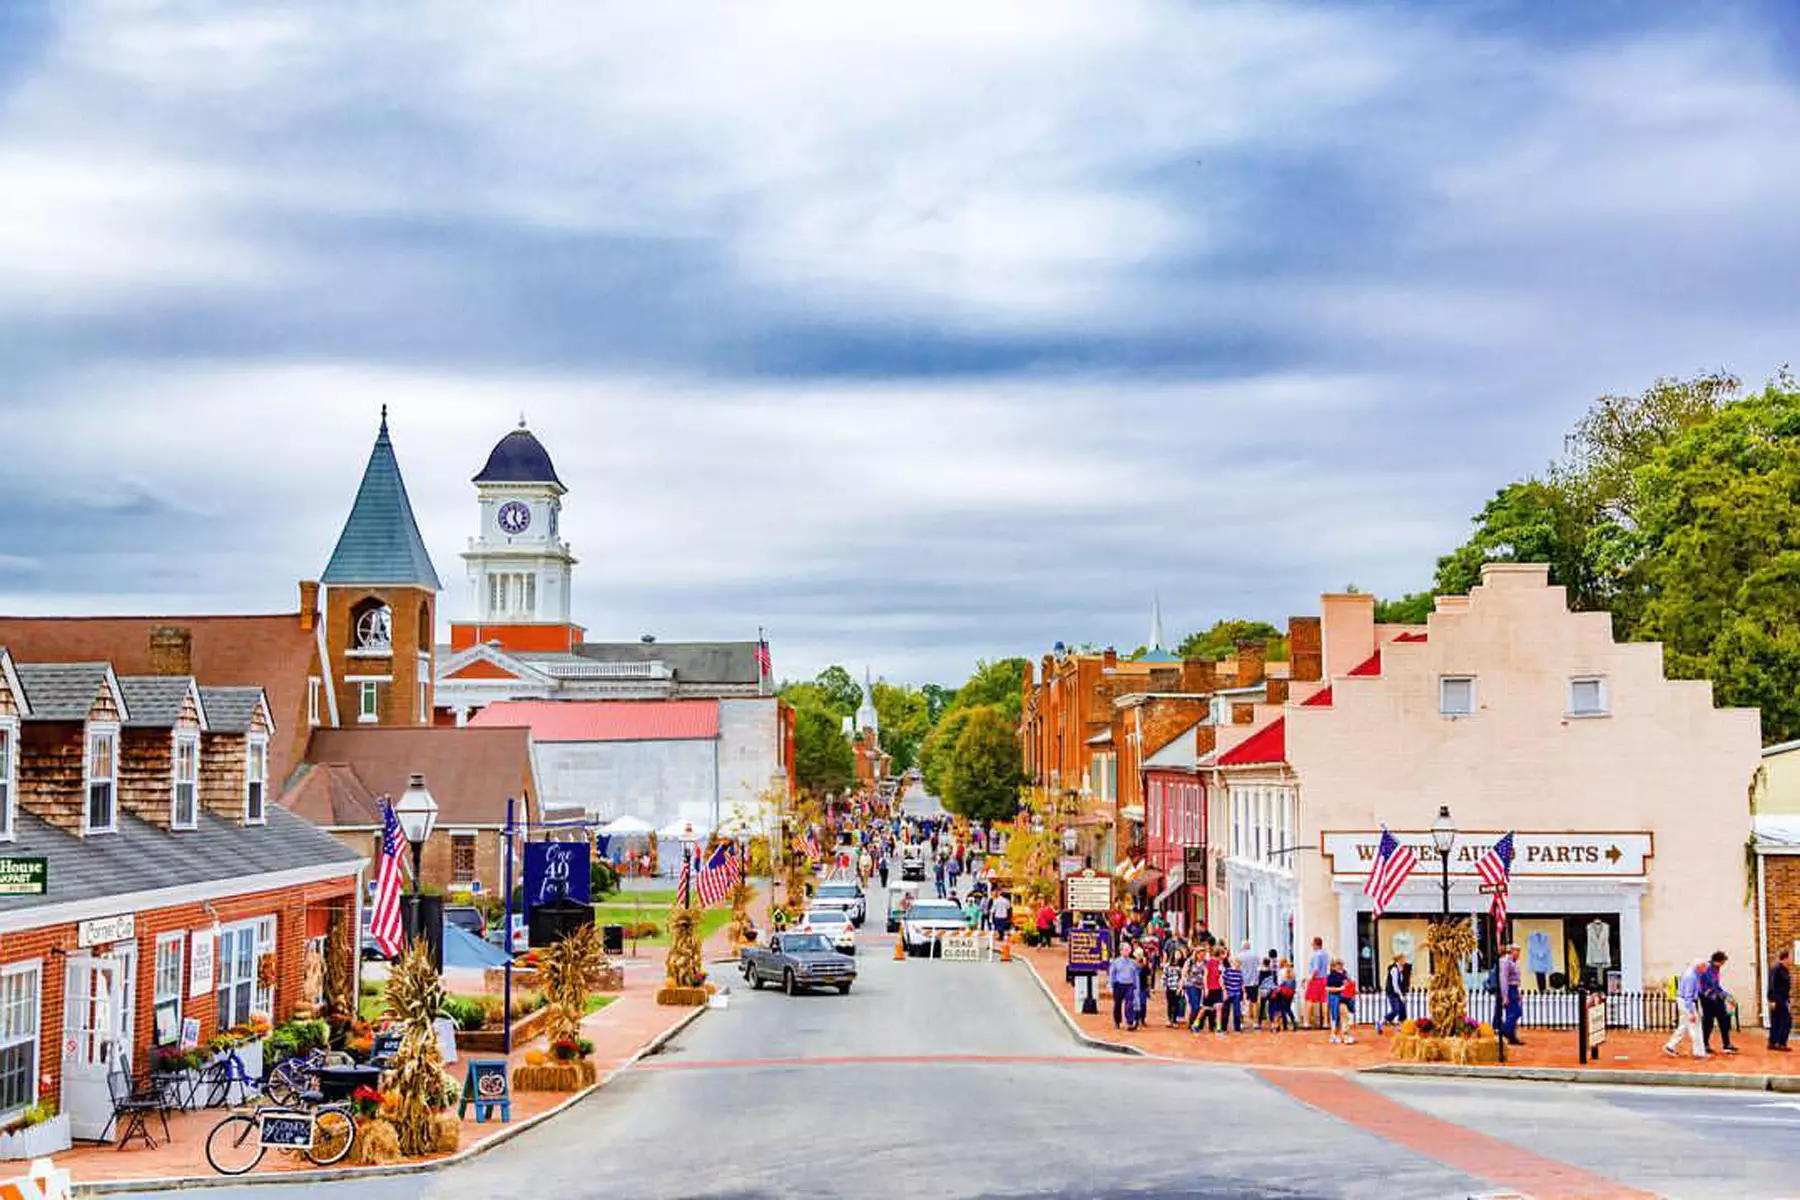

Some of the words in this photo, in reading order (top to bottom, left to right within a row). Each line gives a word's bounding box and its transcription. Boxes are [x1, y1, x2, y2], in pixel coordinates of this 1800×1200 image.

[1527, 846, 1598, 862] PARTS
[949, 940, 973, 948] ROAD
[944, 949, 977, 958] CLOSED
